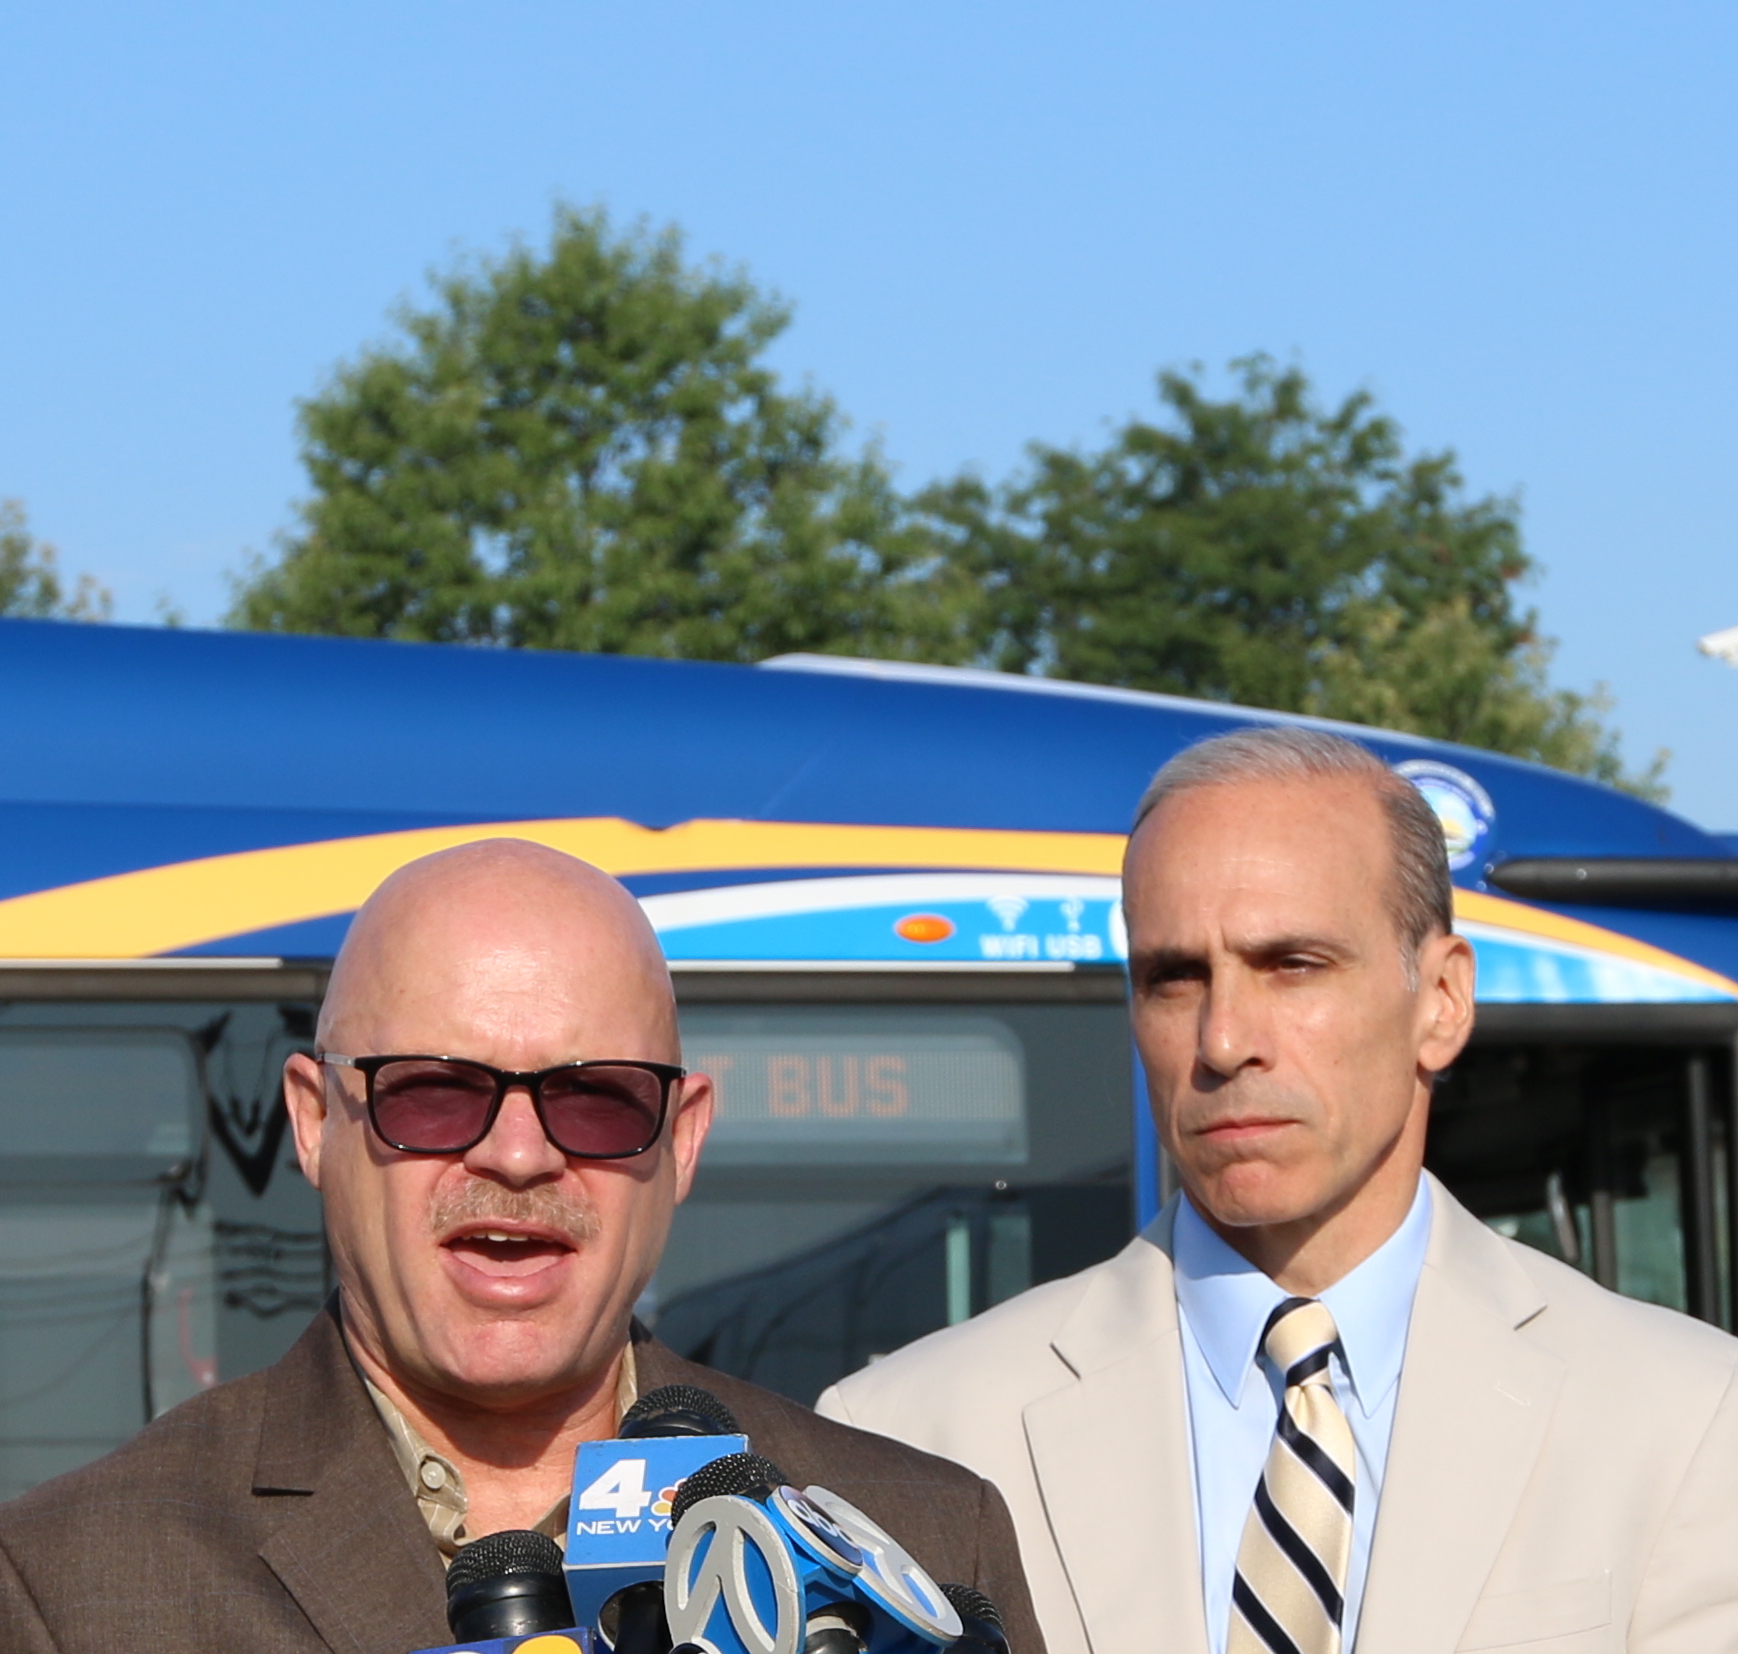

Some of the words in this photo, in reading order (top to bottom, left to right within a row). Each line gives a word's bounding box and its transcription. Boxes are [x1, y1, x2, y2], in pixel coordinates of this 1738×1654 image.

[979, 933, 1039, 960] WIFI
[1045, 933, 1103, 961] USB
[766, 1055, 909, 1119] BUS
[578, 1459, 652, 1518] 4
[576, 1519, 642, 1536] NEW
